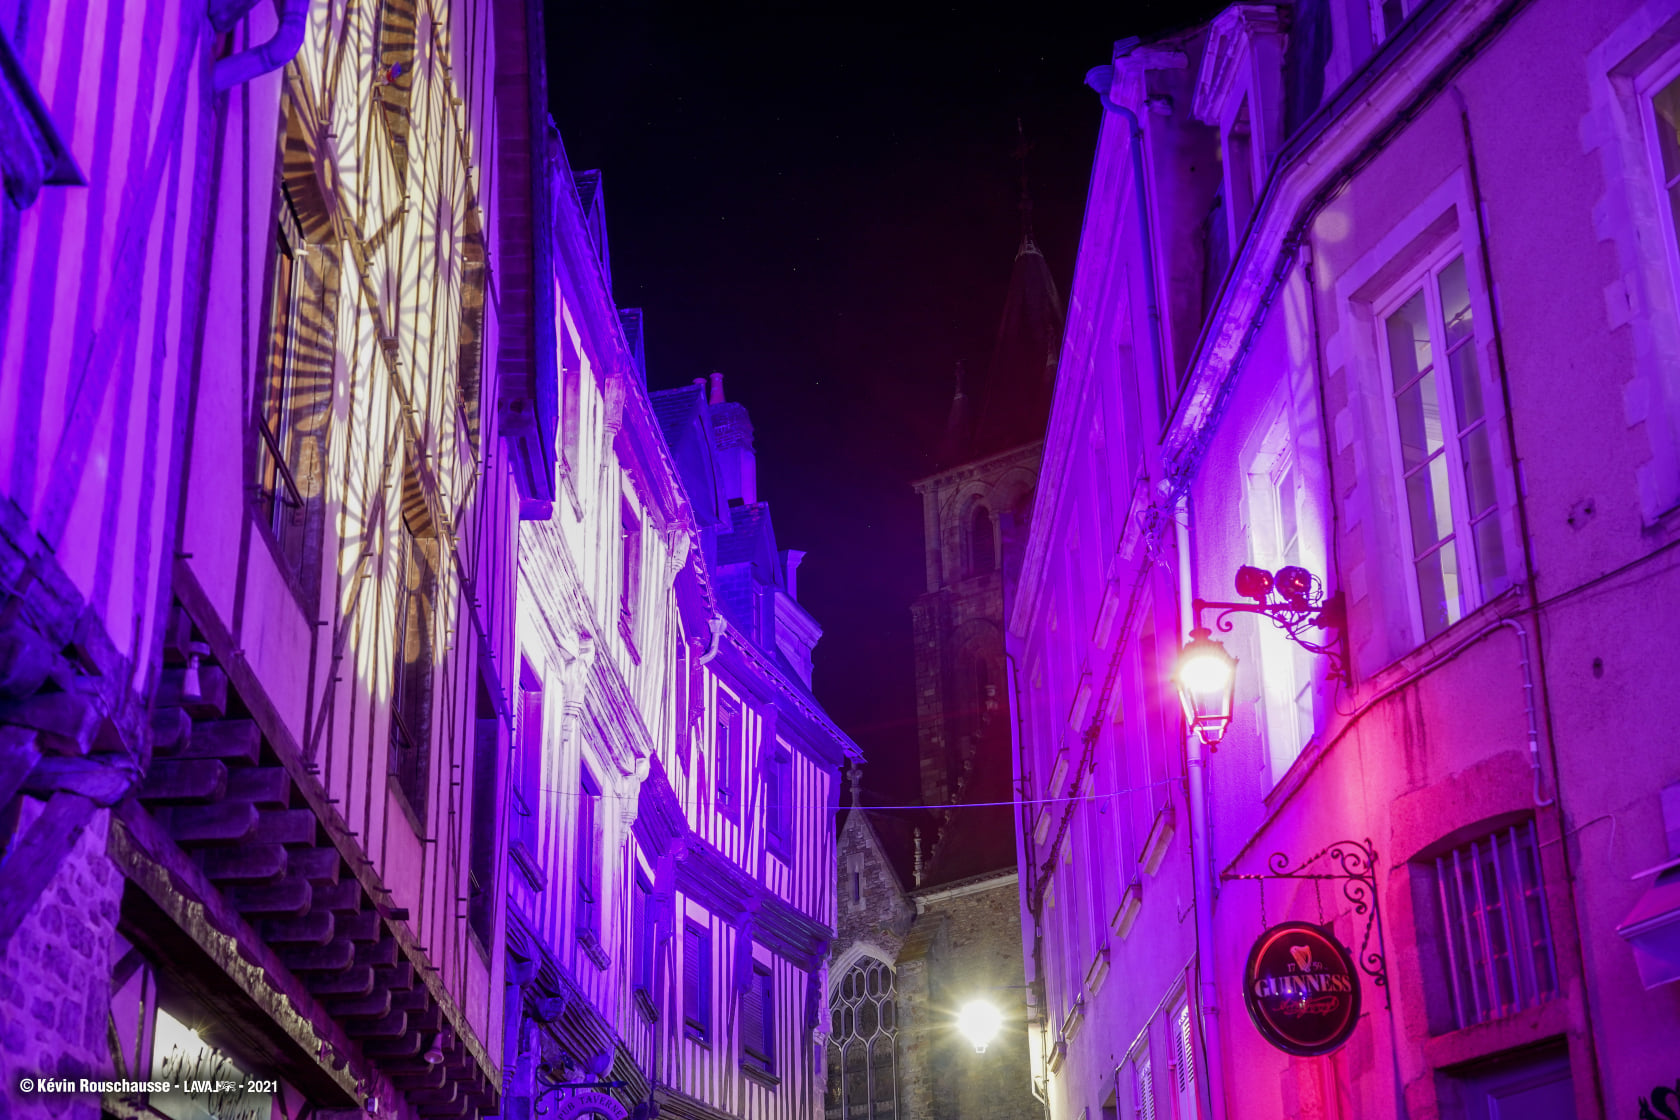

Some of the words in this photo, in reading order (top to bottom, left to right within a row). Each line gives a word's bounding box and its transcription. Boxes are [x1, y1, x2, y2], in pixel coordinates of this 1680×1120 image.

[1254, 973, 1352, 998] GUINNESS
[558, 1102, 576, 1120] PUB
[579, 1094, 624, 1119] TAVERNE
